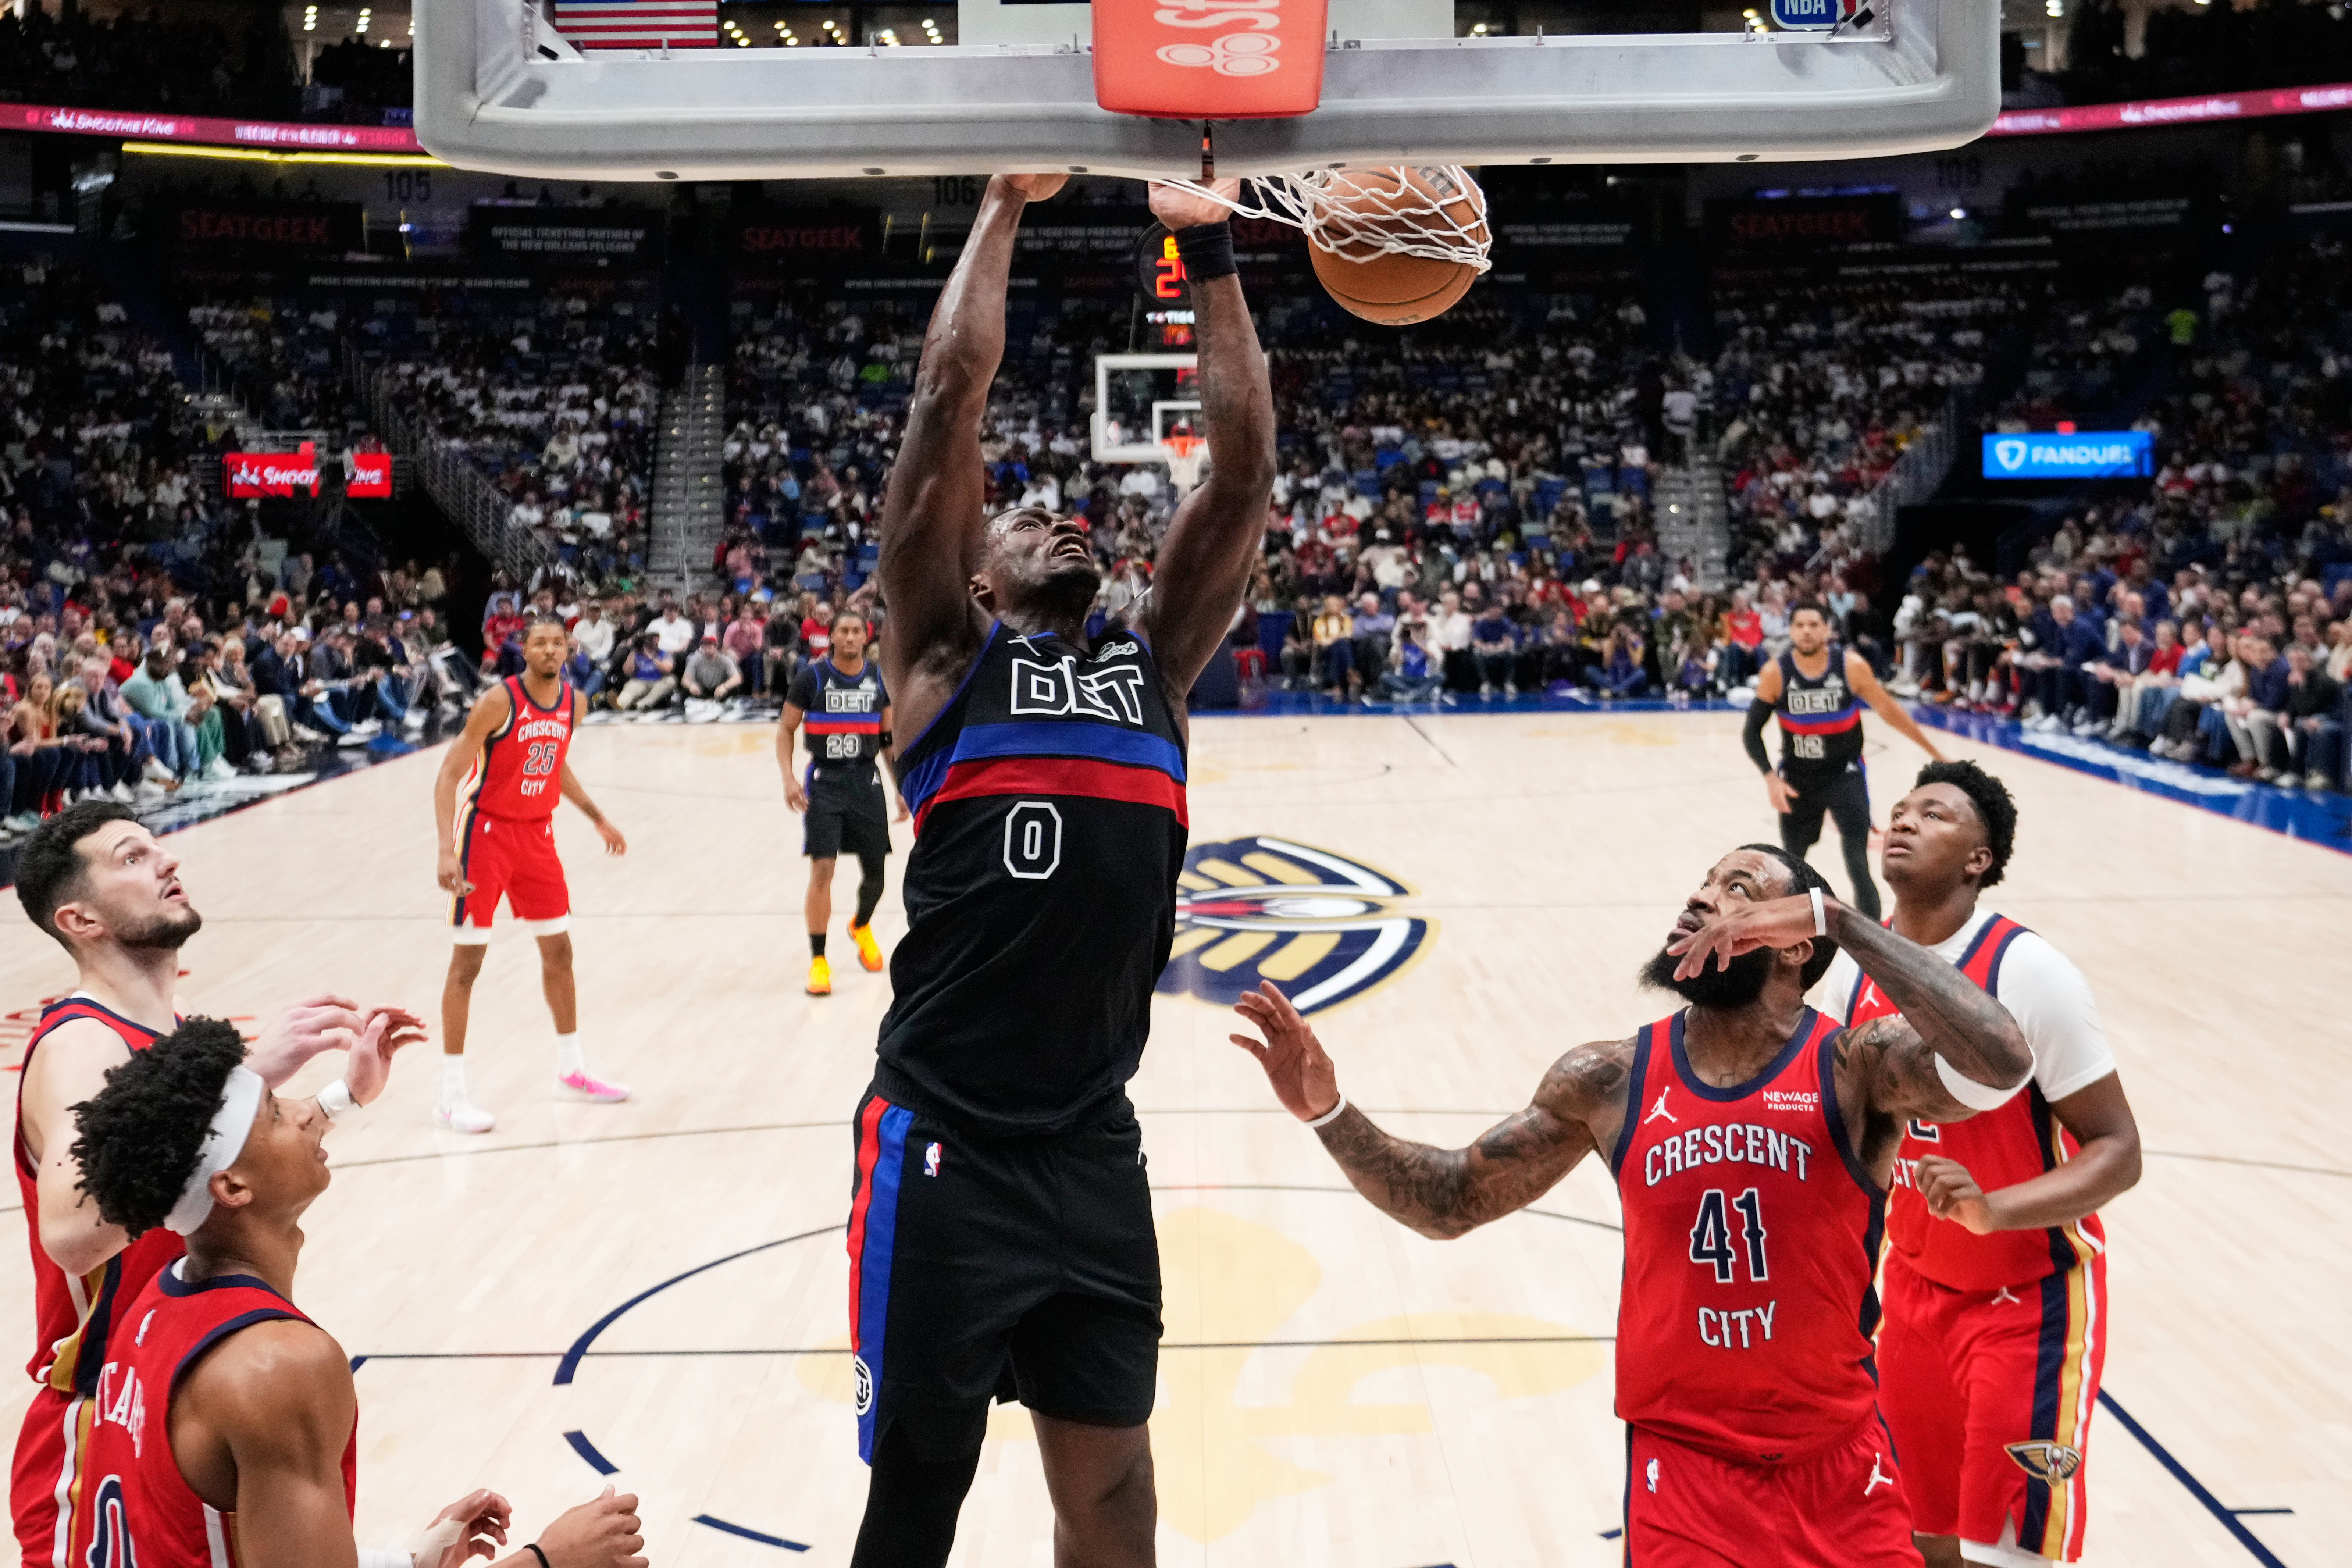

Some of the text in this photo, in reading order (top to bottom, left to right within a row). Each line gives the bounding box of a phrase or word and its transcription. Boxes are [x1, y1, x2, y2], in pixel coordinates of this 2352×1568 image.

[1785, 0, 1825, 14] NBA
[75, 113, 175, 135] SMOOTHIE KING
[235, 126, 278, 142] WELCOME
[300, 128, 339, 144] BLENDER
[384, 171, 430, 202] 105
[933, 177, 976, 205] 106
[180, 207, 329, 244] SEATGEEK
[741, 226, 863, 252] SEATGEEK
[1156, 258, 1187, 298] 2
[352, 469, 382, 485] ING
[825, 689, 875, 713] DET
[1010, 656, 1144, 725] DET
[1788, 689, 1842, 714] DET
[518, 719, 567, 742] CRESCENT
[826, 734, 859, 758] 23
[1793, 734, 1824, 758] 12
[523, 742, 558, 776] 25
[521, 778, 546, 797] CITY
[1003, 801, 1062, 879] 0
[1763, 1091, 1818, 1103] NEWAGE
[1768, 1103, 1814, 1112] PRODUCTS
[1645, 1123, 1812, 1187] CRESCENT
[1689, 1187, 1768, 1284] 41
[1698, 1300, 1776, 1349] CITY
